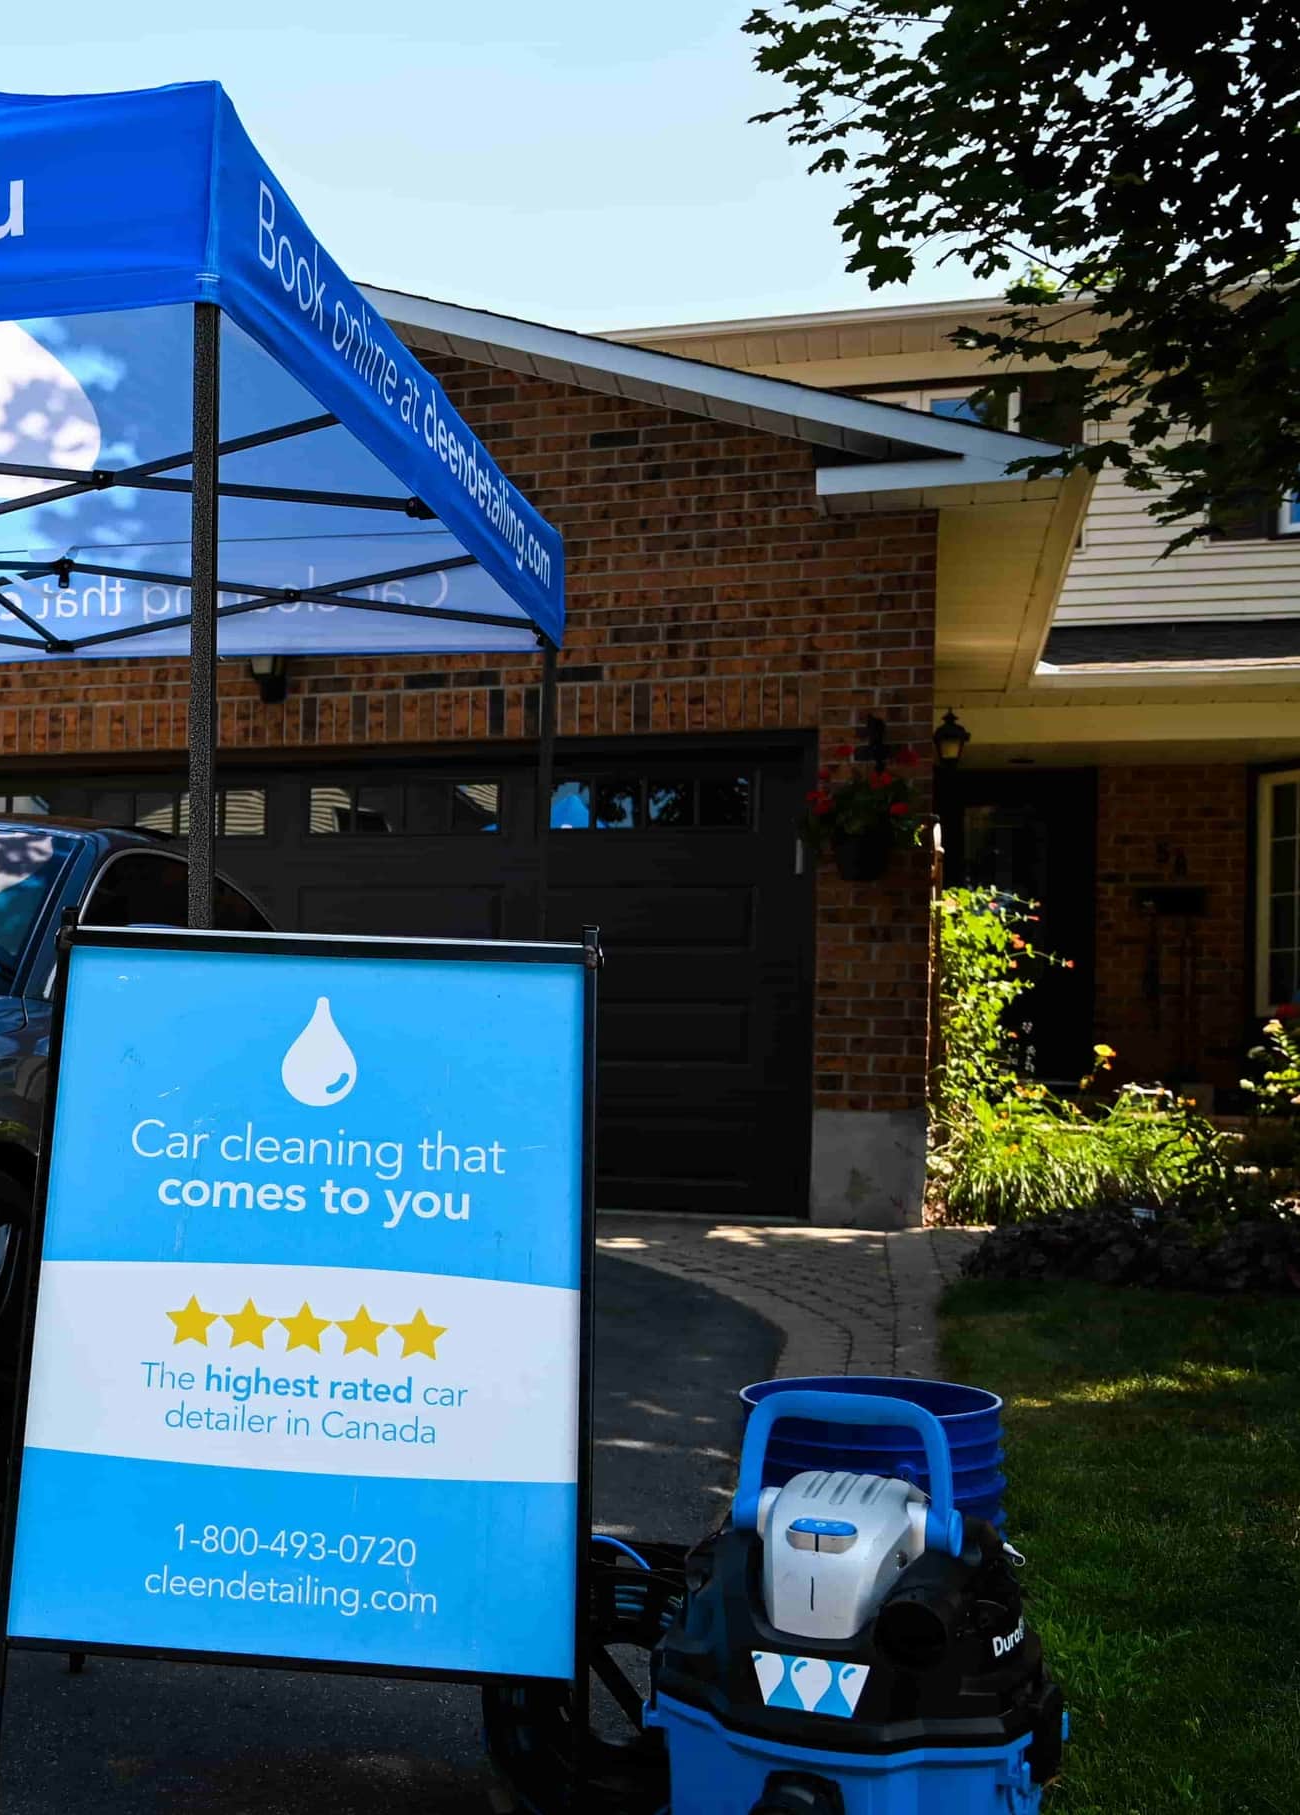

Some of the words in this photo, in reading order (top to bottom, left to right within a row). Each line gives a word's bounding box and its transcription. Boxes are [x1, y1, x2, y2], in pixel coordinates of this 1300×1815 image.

[257, 180, 327, 332] Book
[332, 300, 398, 407] online
[400, 375, 419, 434] at
[423, 388, 551, 589] cleendetailing.com
[131, 1119, 210, 1160] Car
[219, 1121, 403, 1180] cleaning
[417, 1132, 506, 1175] that
[157, 1176, 306, 1213] comes
[320, 1179, 369, 1215] to
[383, 1190, 470, 1229] you
[140, 1361, 195, 1391] The
[204, 1363, 319, 1402] highest
[329, 1375, 413, 1404] rated
[422, 1385, 468, 1408] car
[164, 1401, 278, 1435] detailer
[286, 1409, 310, 1437] in
[320, 1411, 437, 1444] Canada
[173, 1522, 417, 1568] 1-800-493-0720
[144, 1564, 438, 1616] cleendetailing.com
